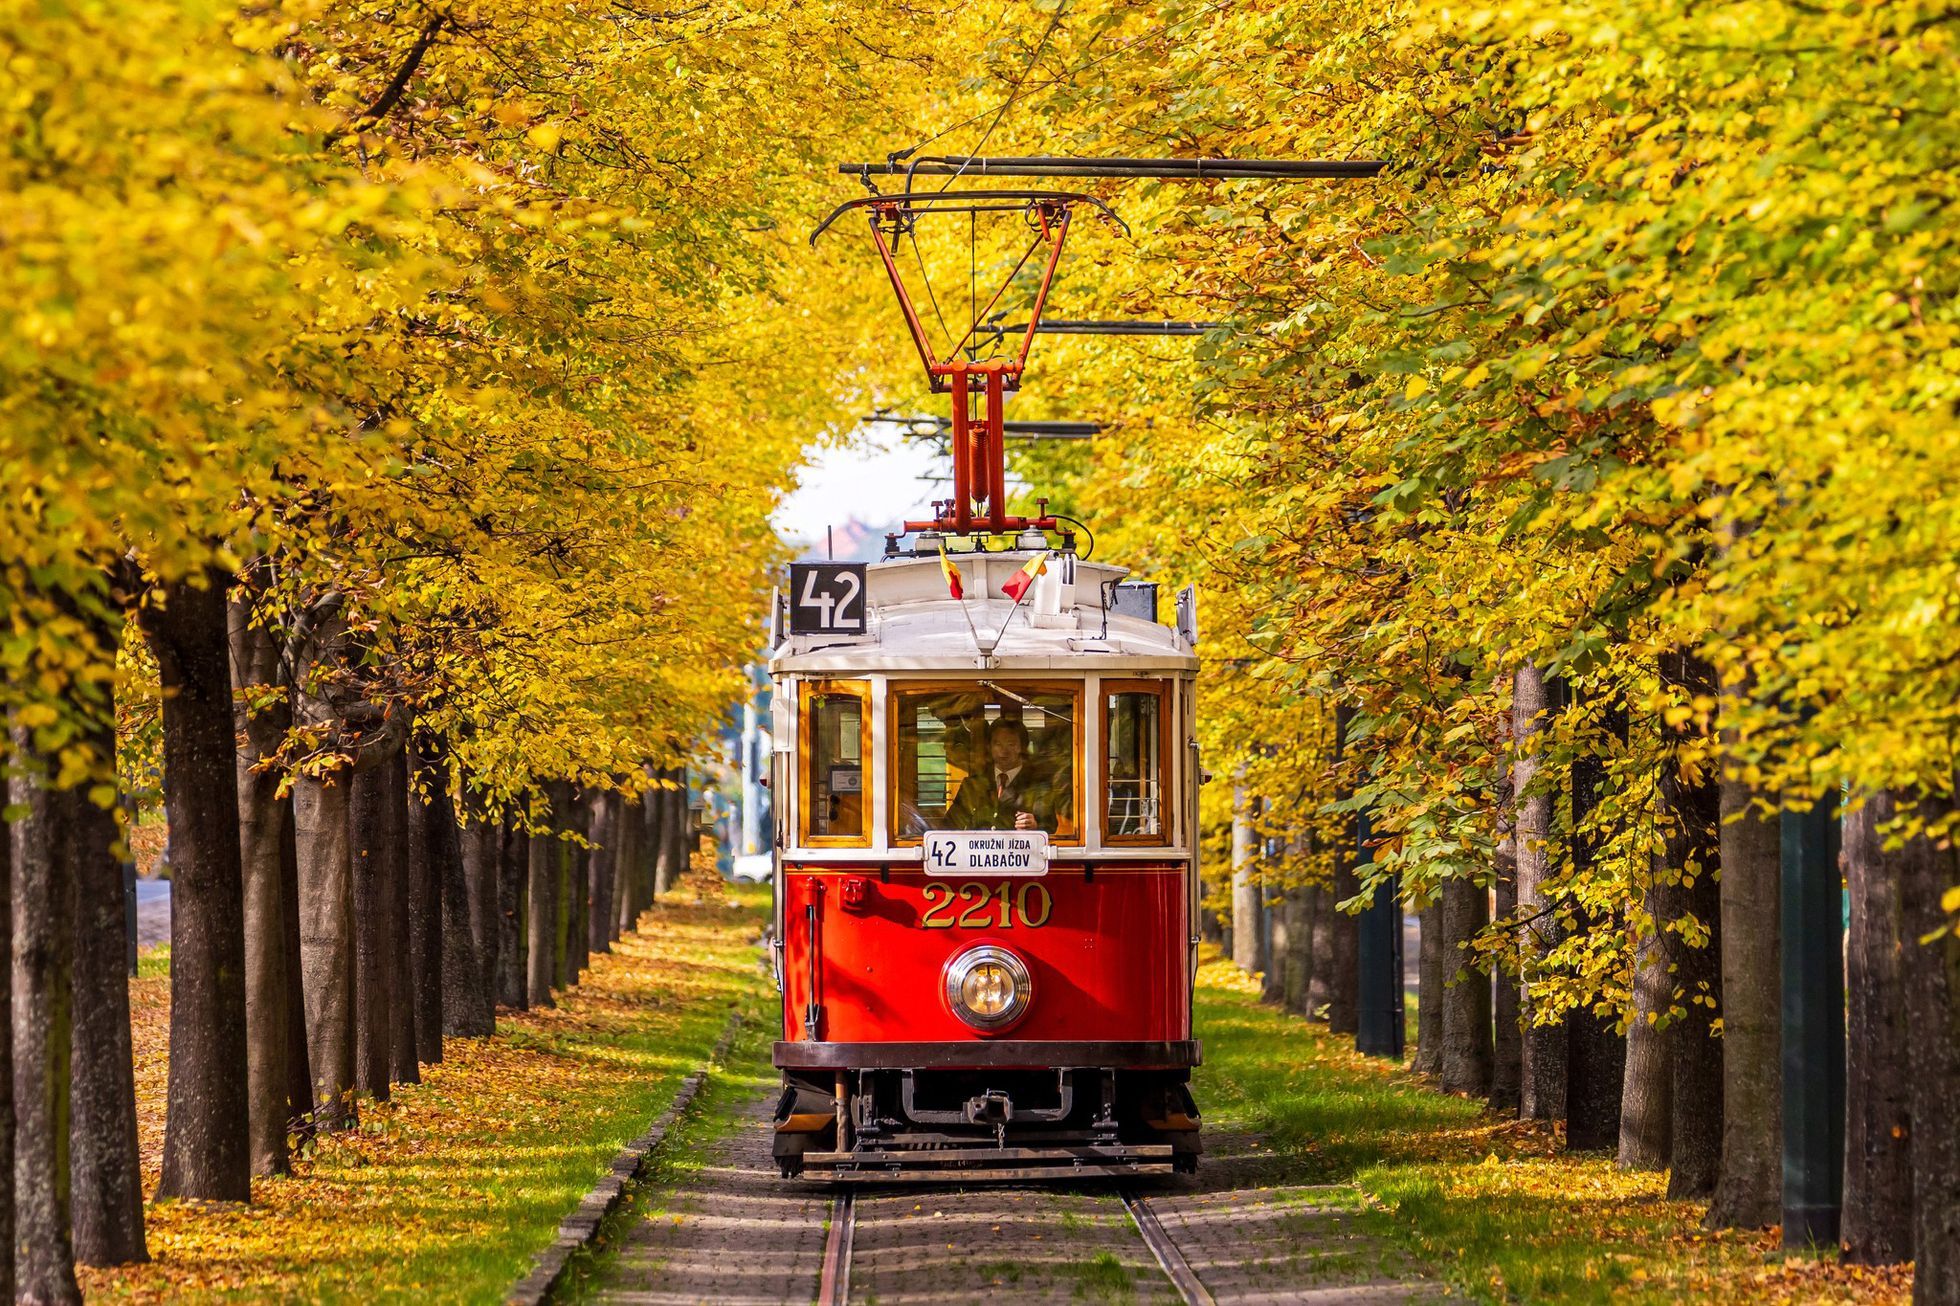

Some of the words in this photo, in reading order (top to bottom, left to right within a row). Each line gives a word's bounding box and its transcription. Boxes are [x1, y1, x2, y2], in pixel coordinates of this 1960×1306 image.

[799, 570, 860, 628] 42
[931, 841, 957, 866] 42
[968, 839, 1004, 850] OKRUŽNÍ
[1008, 839, 1031, 850] JÍZDA
[969, 851, 1030, 867] DLABAČOV
[922, 881, 1052, 928] 2210
